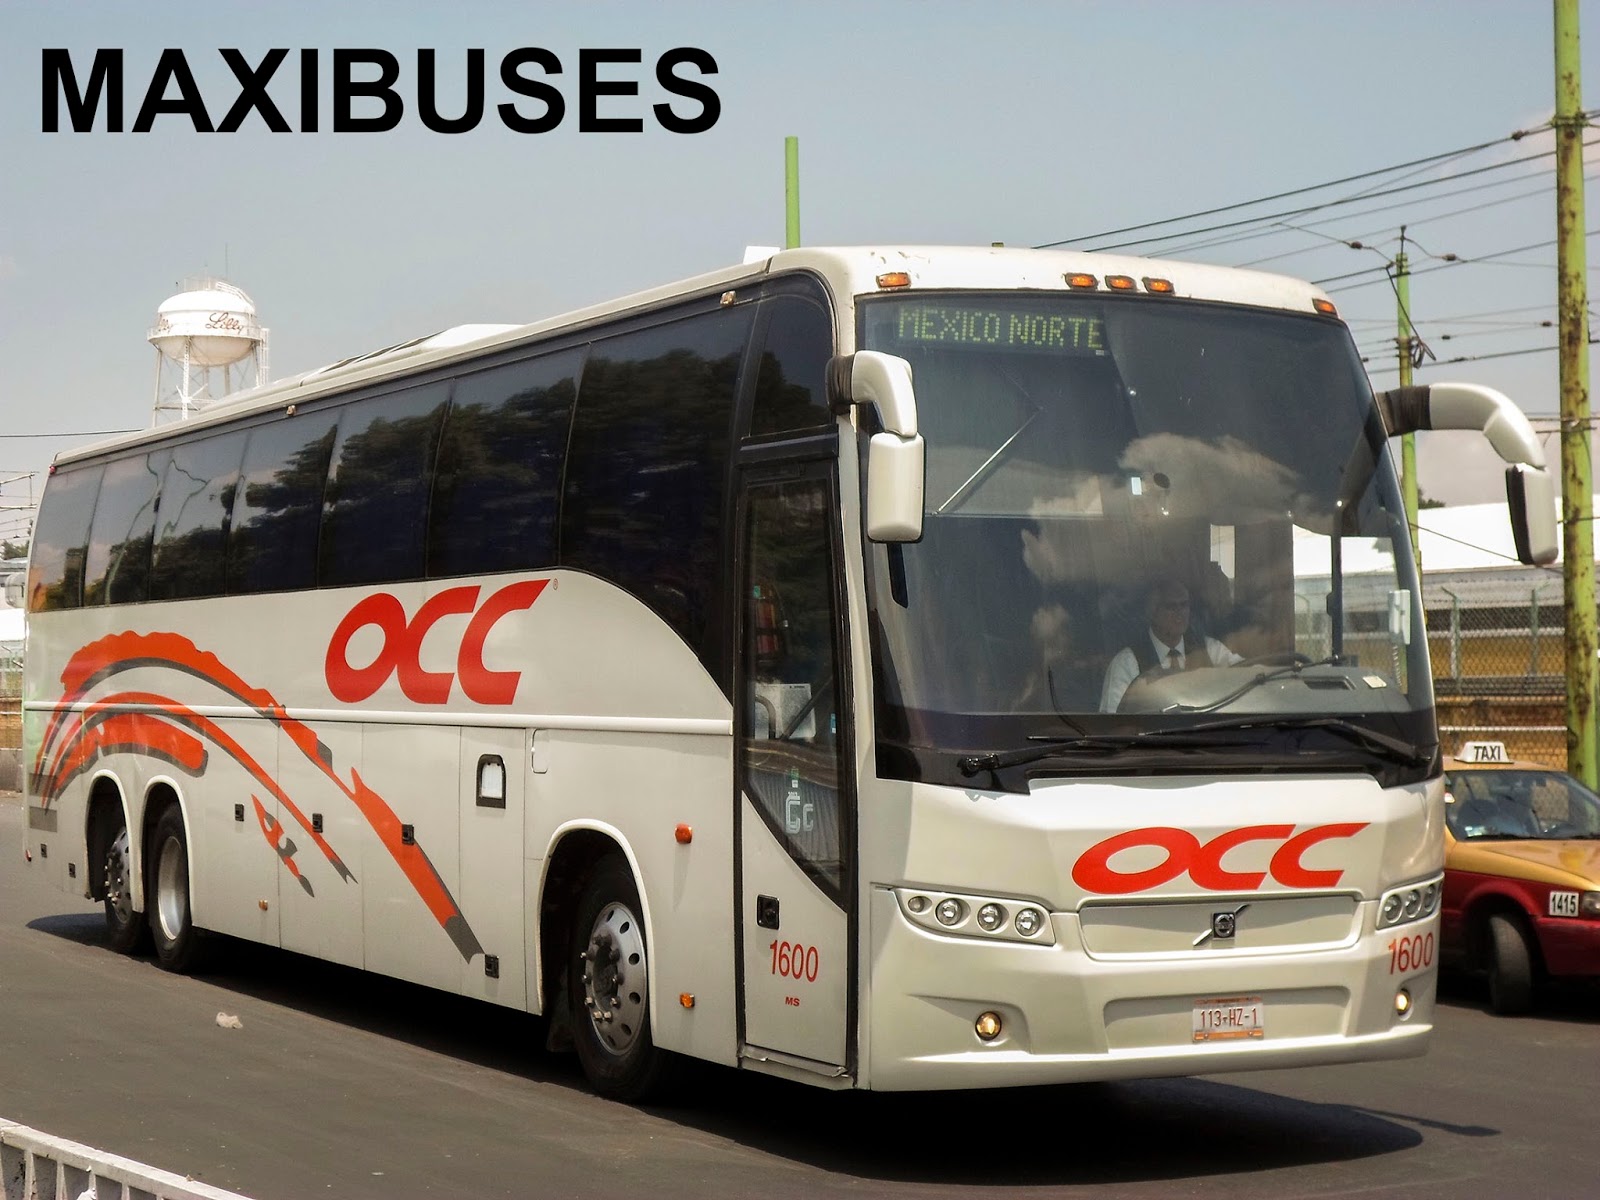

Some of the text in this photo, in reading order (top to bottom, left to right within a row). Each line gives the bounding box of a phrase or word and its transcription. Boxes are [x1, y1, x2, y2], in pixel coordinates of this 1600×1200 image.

[205, 312, 244, 334] Lilly
[899, 307, 1103, 348] MEXICO NORTE
[325, 579, 550, 705] OCC
[1474, 746, 1501, 761] TAXI
[1071, 822, 1371, 894] OCC
[1551, 892, 1576, 914] 1415
[769, 940, 819, 983] 1600
[1388, 932, 1433, 975] 1600
[785, 996, 800, 1007] MS
[1200, 1006, 1257, 1028] 113-HZ-1
